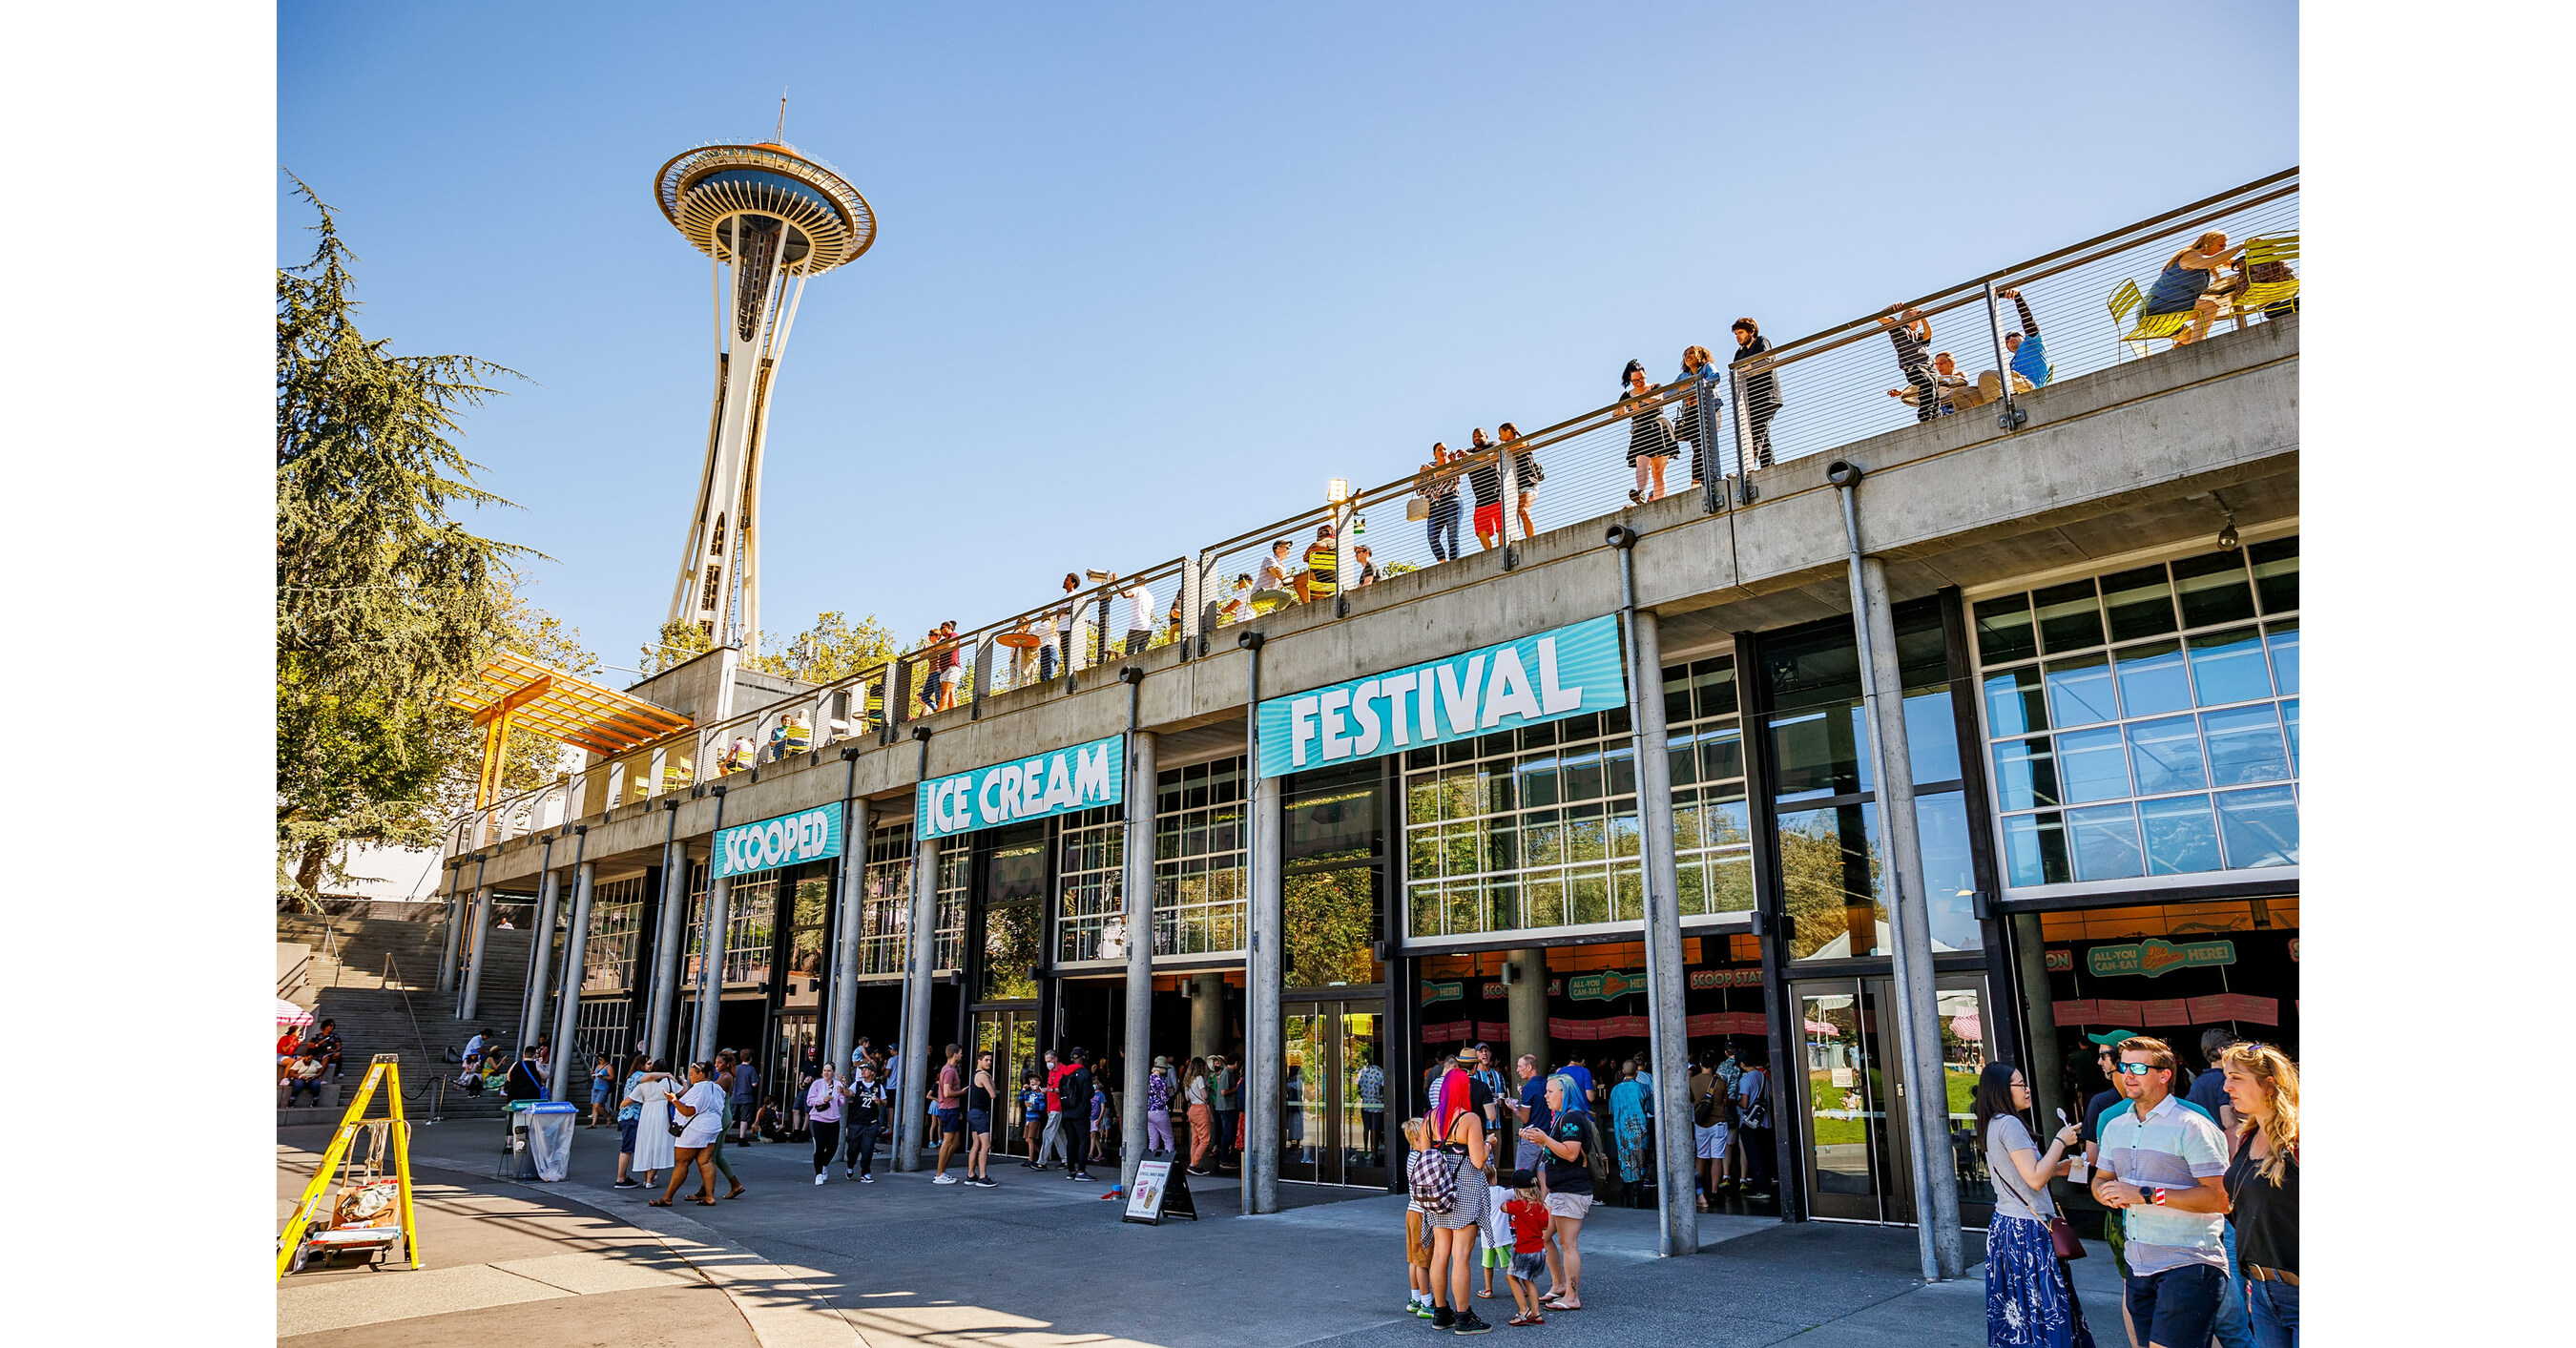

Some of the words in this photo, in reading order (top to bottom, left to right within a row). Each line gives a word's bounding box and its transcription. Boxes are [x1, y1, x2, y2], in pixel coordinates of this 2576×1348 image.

[1291, 636, 1583, 767] FESTIVAL
[926, 776, 973, 836] ICE
[978, 743, 1111, 824] CREAM
[723, 811, 828, 875] SCOOPED
[2094, 950, 2136, 962] ALL-YOU
[2188, 946, 2229, 961] HERE!
[2095, 960, 2138, 970] CAN-EAT
[1630, 978, 1647, 988] HER
[1693, 971, 1732, 985] SCOOP
[1736, 970, 1763, 984] STAT
[1573, 980, 1600, 988] ALL-YOU
[1440, 986, 1460, 996] HERE!
[1485, 985, 1508, 996] SCOO
[1573, 987, 1600, 996] CAN-EAT
[862, 1097, 872, 1108] 22
